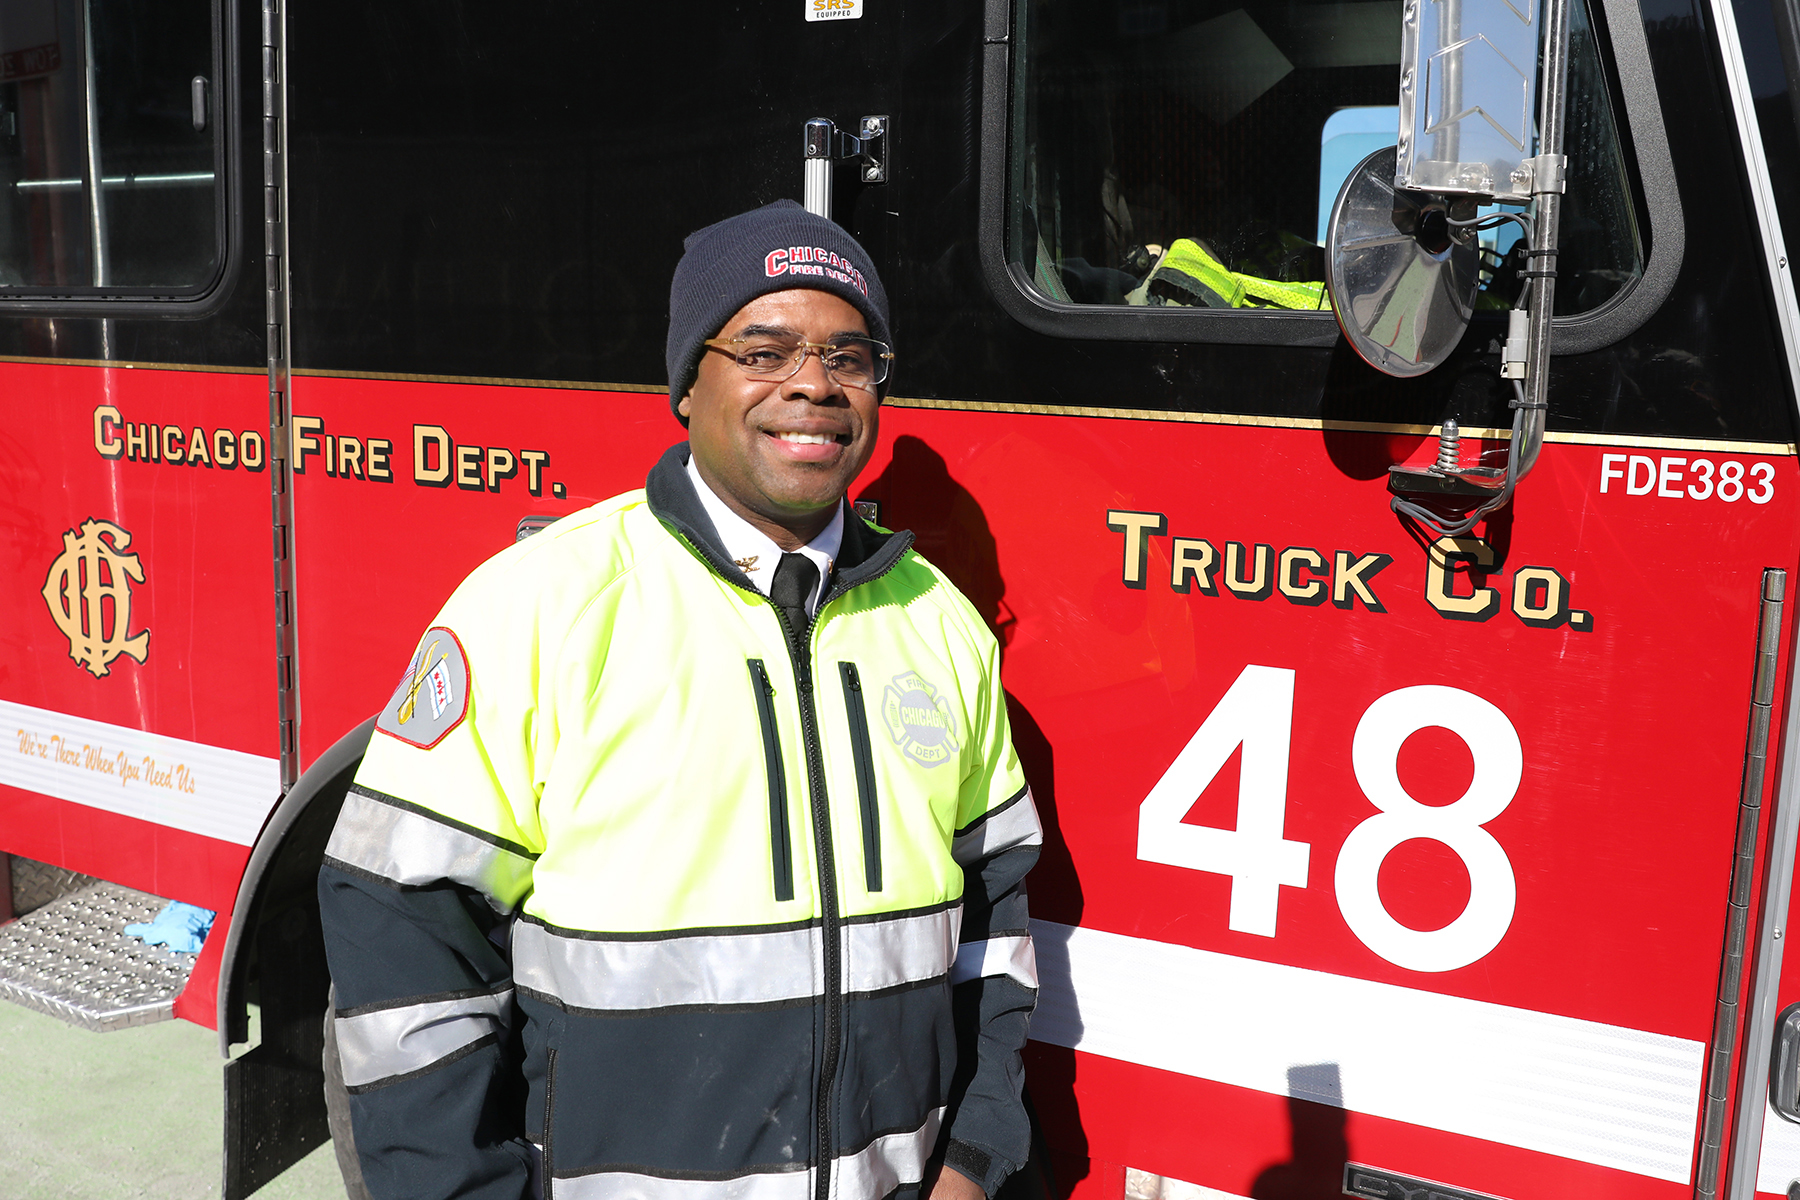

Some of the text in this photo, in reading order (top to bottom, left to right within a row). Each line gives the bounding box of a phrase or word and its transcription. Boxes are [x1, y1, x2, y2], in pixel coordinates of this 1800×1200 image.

[813, 0, 854, 10] SRS
[816, 10, 851, 18] EQUIPPED
[765, 246, 868, 298] CHICAGO
[789, 264, 824, 276] FIRE
[93, 405, 567, 500] CHICAGO FIRE DEPT.
[1600, 453, 1776, 505] FDE383
[1106, 509, 1594, 633] TRUCK CO.
[901, 706, 946, 729] CHICAGO
[17, 729, 196, 794] We're There When You Need Us
[916, 746, 940, 759] DEPT
[1137, 664, 1523, 973] 48
